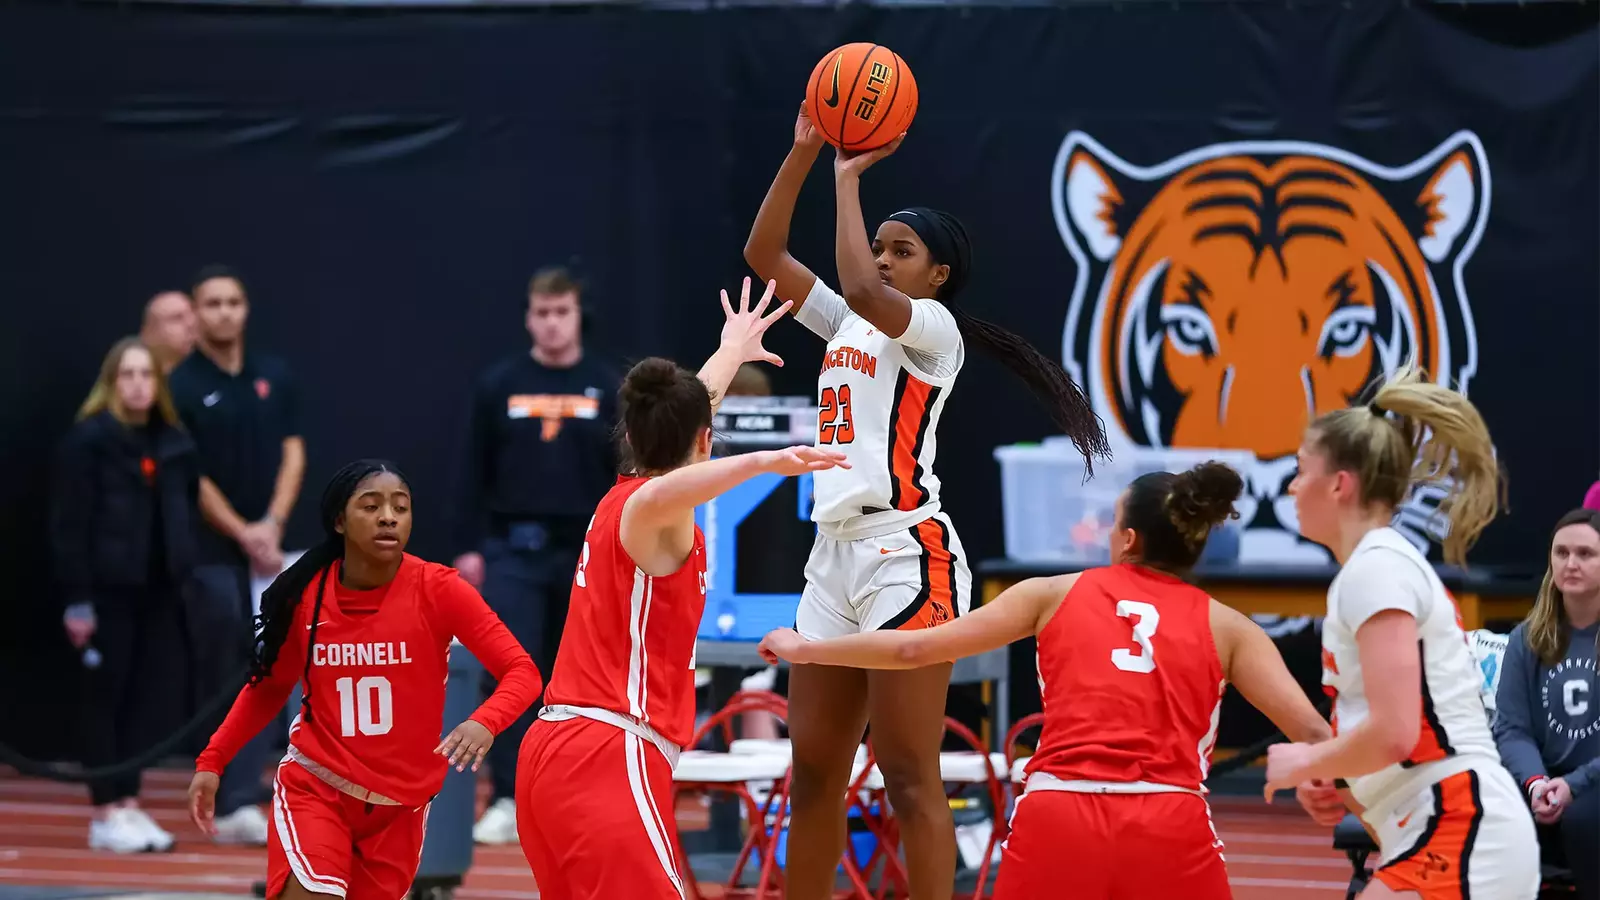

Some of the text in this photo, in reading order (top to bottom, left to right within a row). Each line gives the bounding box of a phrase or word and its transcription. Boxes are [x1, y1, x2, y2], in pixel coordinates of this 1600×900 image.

[853, 61, 888, 121] ELITE
[819, 383, 855, 445] 23
[312, 641, 412, 666] CORNELL
[1110, 599, 1160, 674] 3
[1548, 657, 1598, 679] CORNEL
[1562, 679, 1589, 716] C
[335, 676, 393, 737] 10
